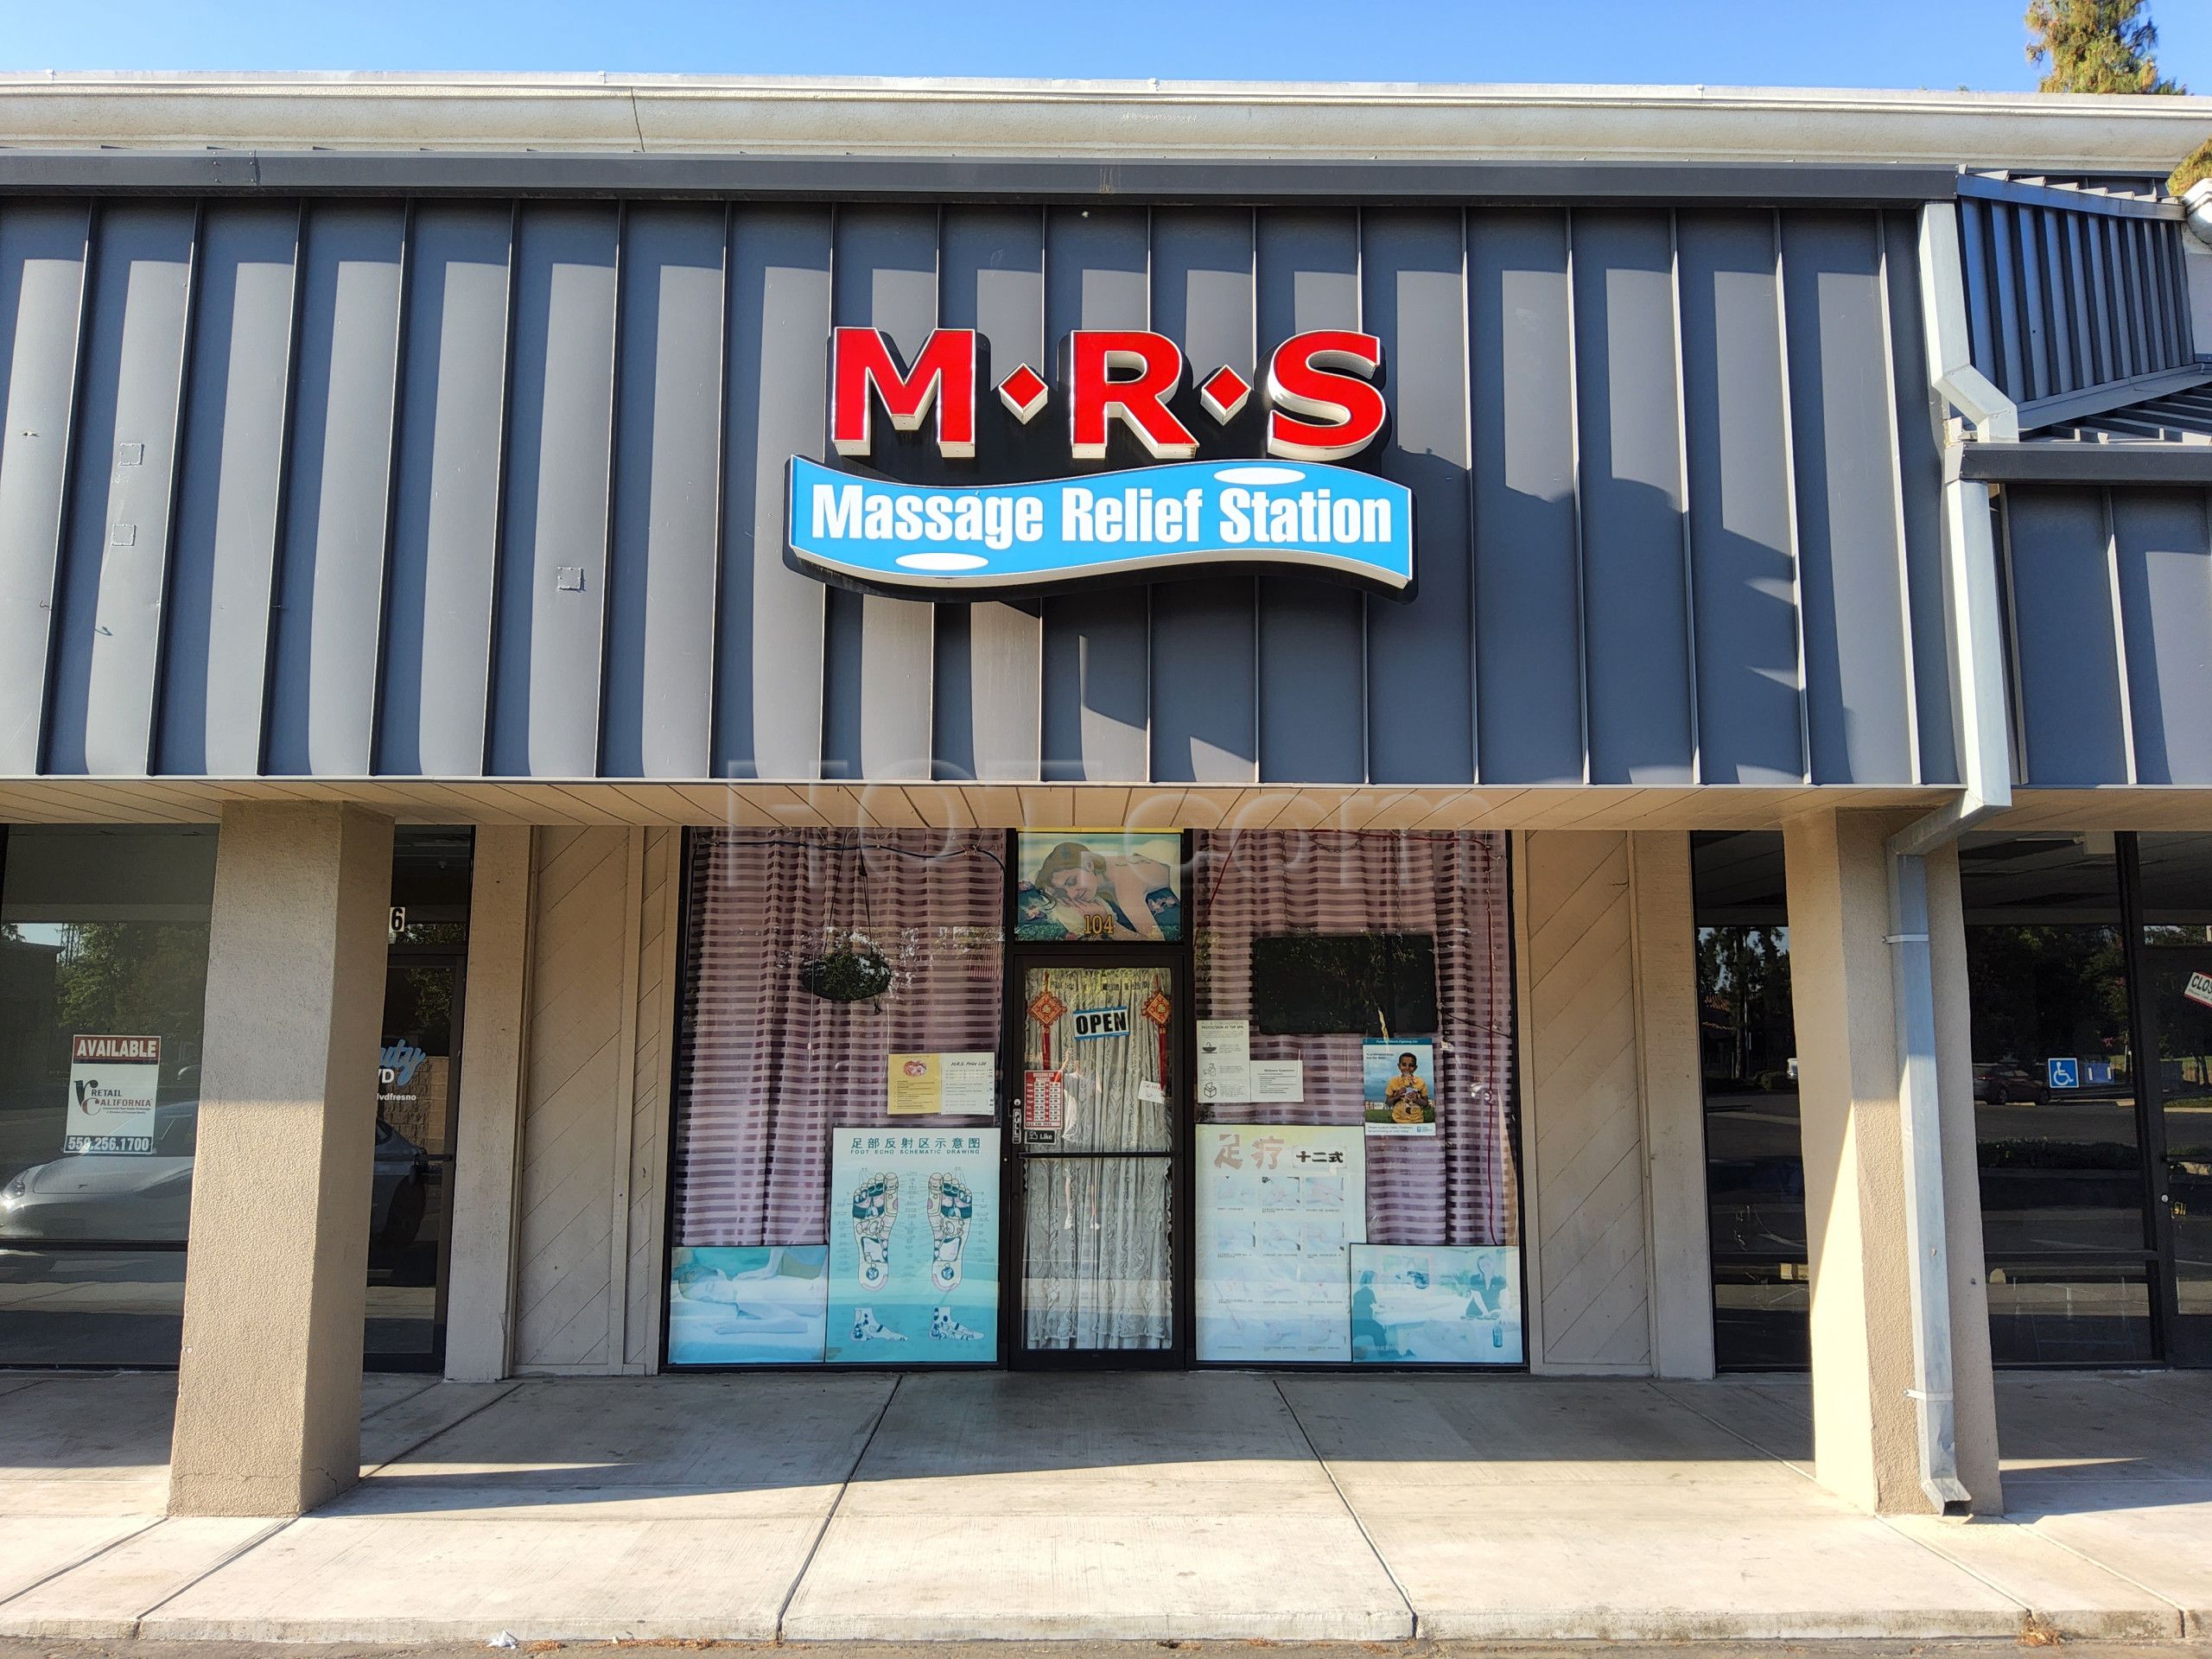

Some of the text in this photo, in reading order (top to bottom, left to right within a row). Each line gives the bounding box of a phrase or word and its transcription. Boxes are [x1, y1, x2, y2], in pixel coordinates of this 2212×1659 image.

[812, 484, 1391, 550] Massage Relief Station
[1084, 914, 1114, 934] 104
[1076, 1011, 1127, 1035] OPEN
[77, 1039, 156, 1058] AVAILABLE
[851, 1137, 981, 1149] 足部反射区示意图
[1296, 1150, 1344, 1163] 十二式
